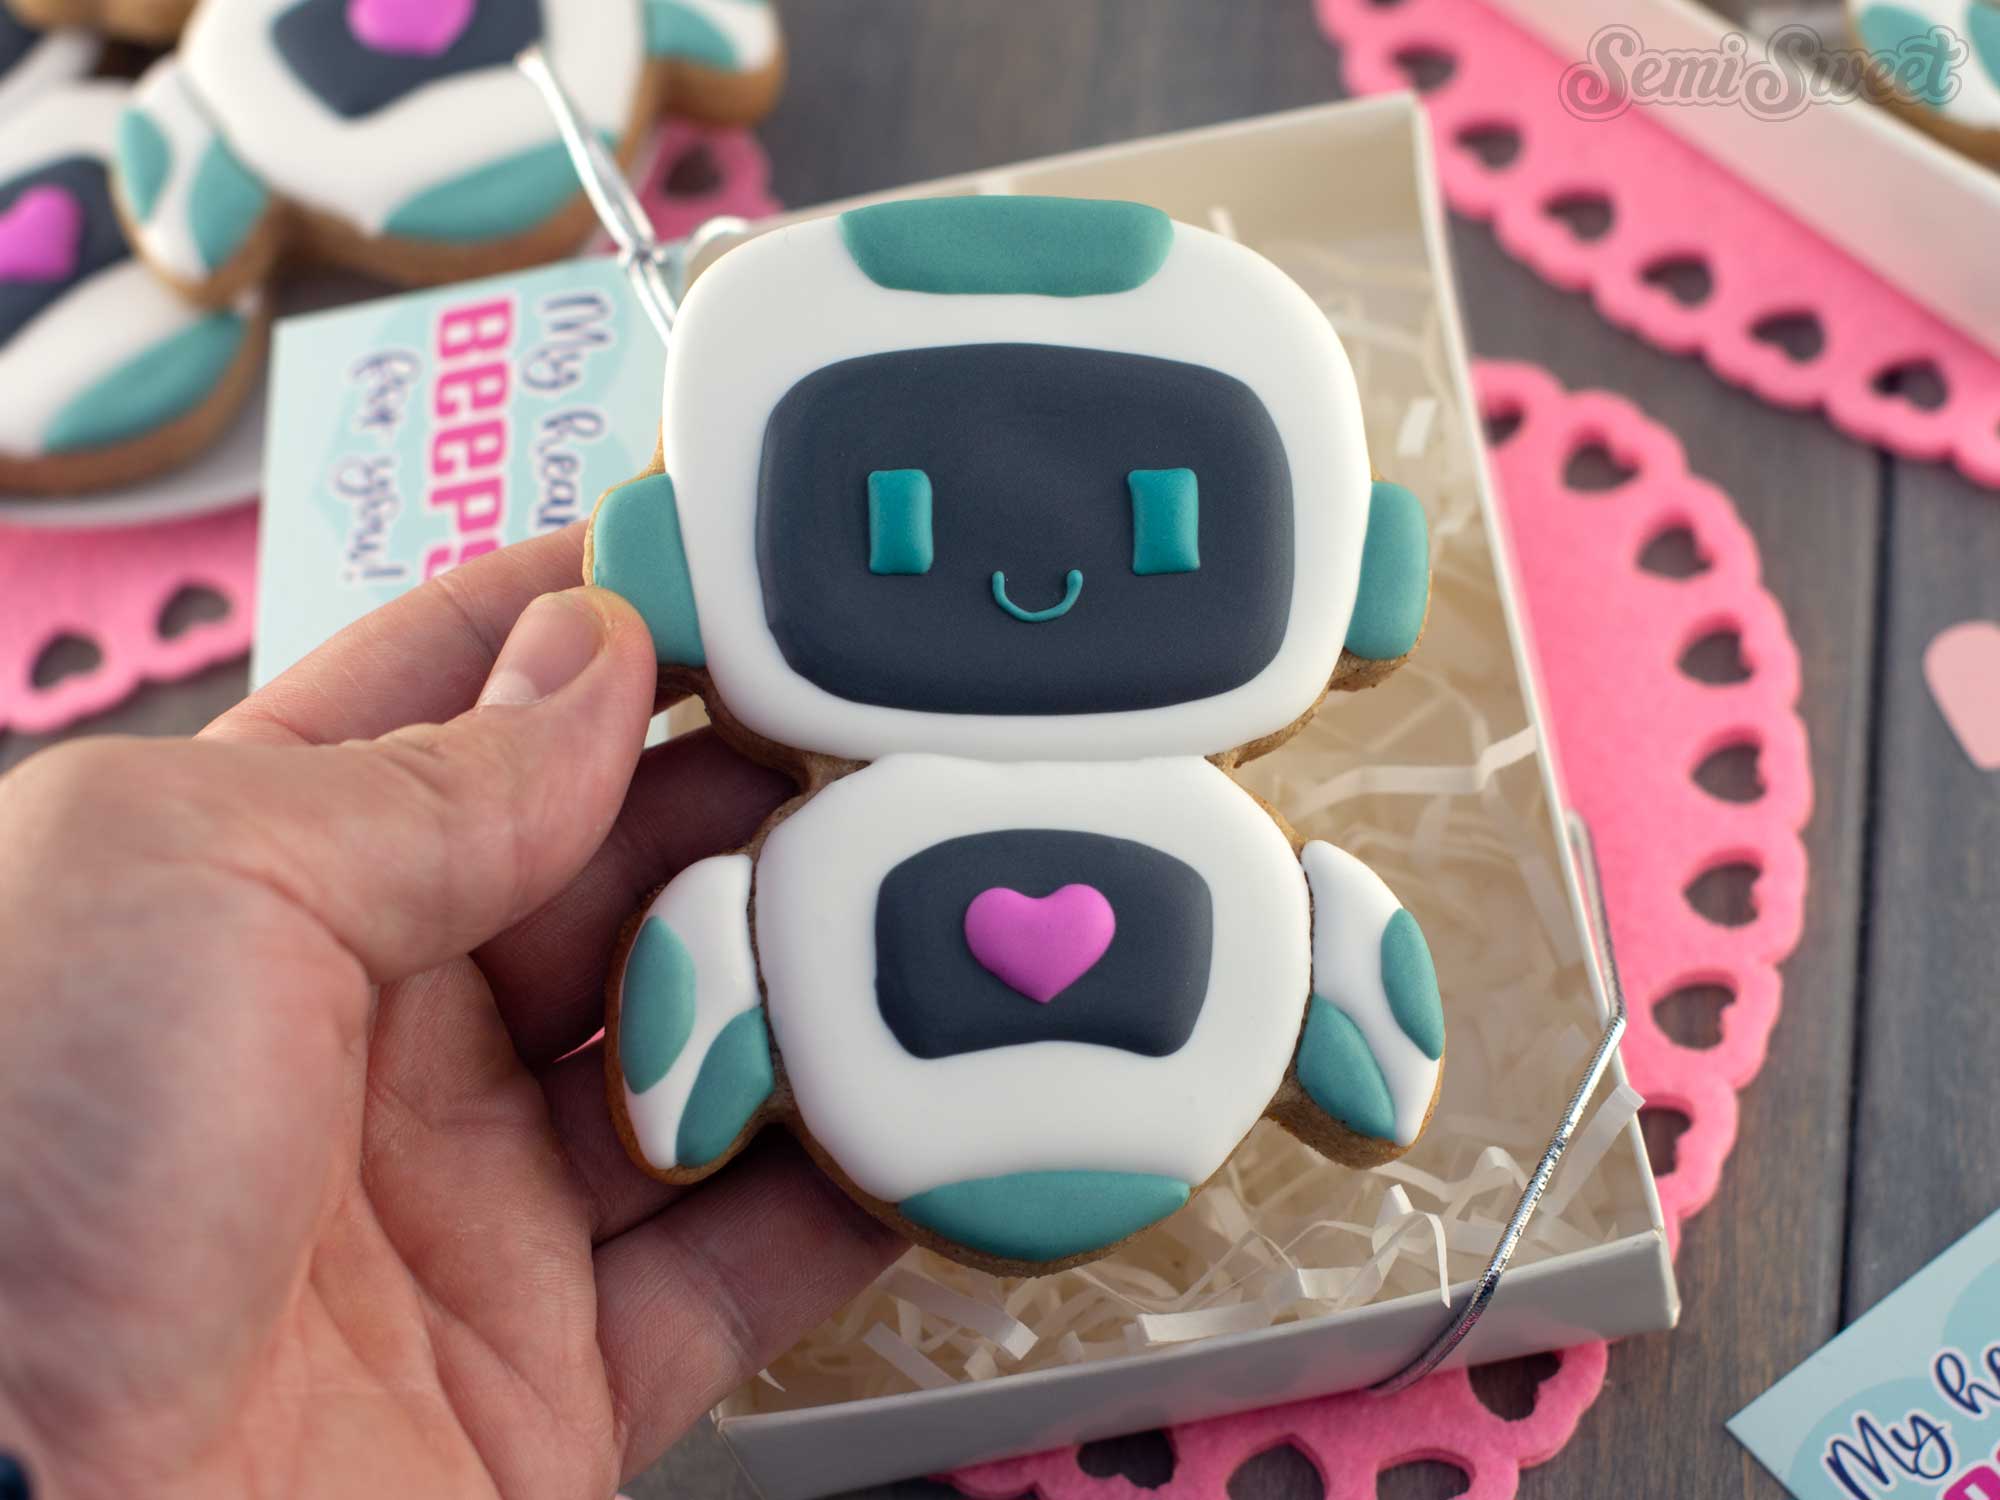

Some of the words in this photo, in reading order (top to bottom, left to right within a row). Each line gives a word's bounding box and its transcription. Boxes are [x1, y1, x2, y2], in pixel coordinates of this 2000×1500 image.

[524, 293, 608, 389] My
[352, 351, 421, 430] for
[335, 454, 406, 581] you!
[537, 410, 604, 530] hear
[1827, 1415, 1952, 1500] My
